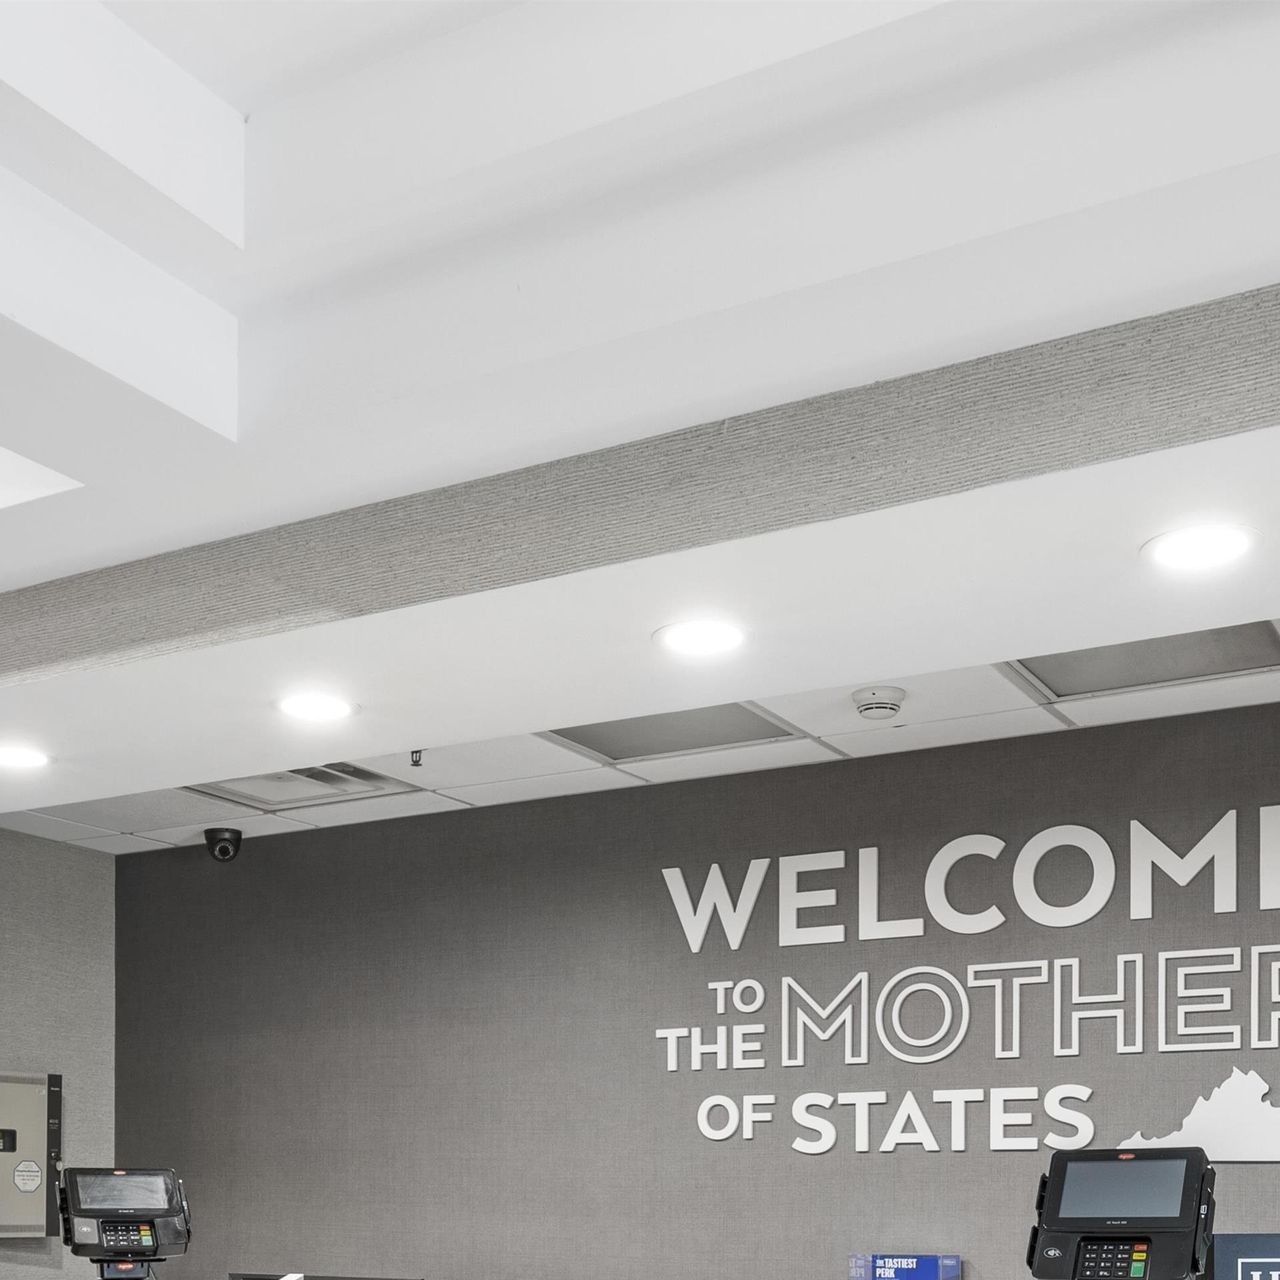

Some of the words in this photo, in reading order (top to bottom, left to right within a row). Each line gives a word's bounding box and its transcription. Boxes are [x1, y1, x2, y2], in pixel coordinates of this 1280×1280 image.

[708, 979, 765, 1014] TO
[655, 1023, 766, 1071] THE
[697, 1094, 775, 1141] OF
[790, 1084, 1097, 1156] STATES
[875, 1268, 896, 1278] PERK
[884, 1258, 918, 1269] TASTIEST
